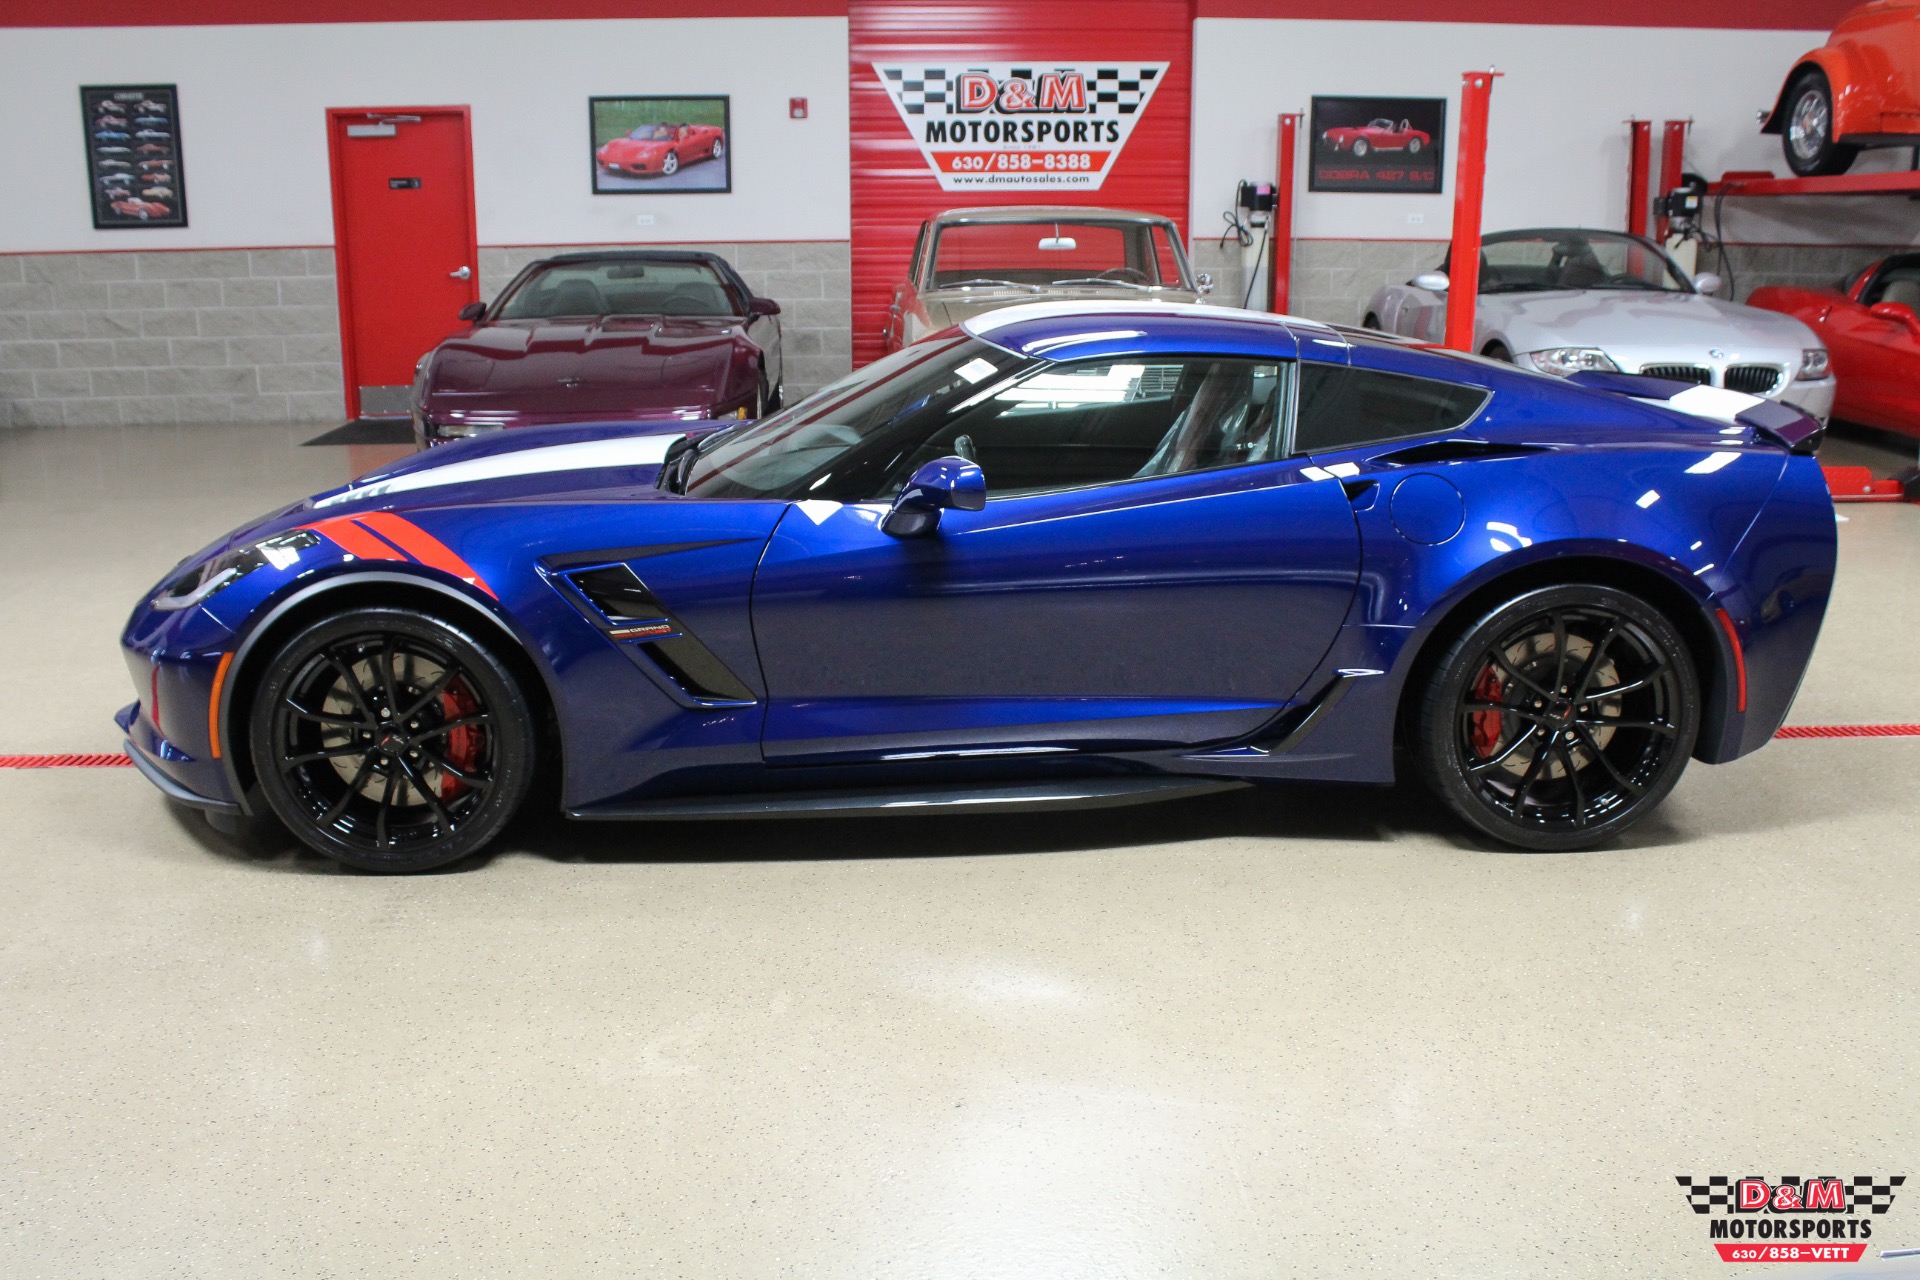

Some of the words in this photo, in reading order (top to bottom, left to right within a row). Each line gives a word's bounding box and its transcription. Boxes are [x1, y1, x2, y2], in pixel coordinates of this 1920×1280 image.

[956, 72, 1087, 113] D&M
[925, 120, 1120, 143] MOTORSPORTS
[952, 152, 1091, 171] 630/858-8388
[953, 174, 1090, 184] www.dmautosales.com
